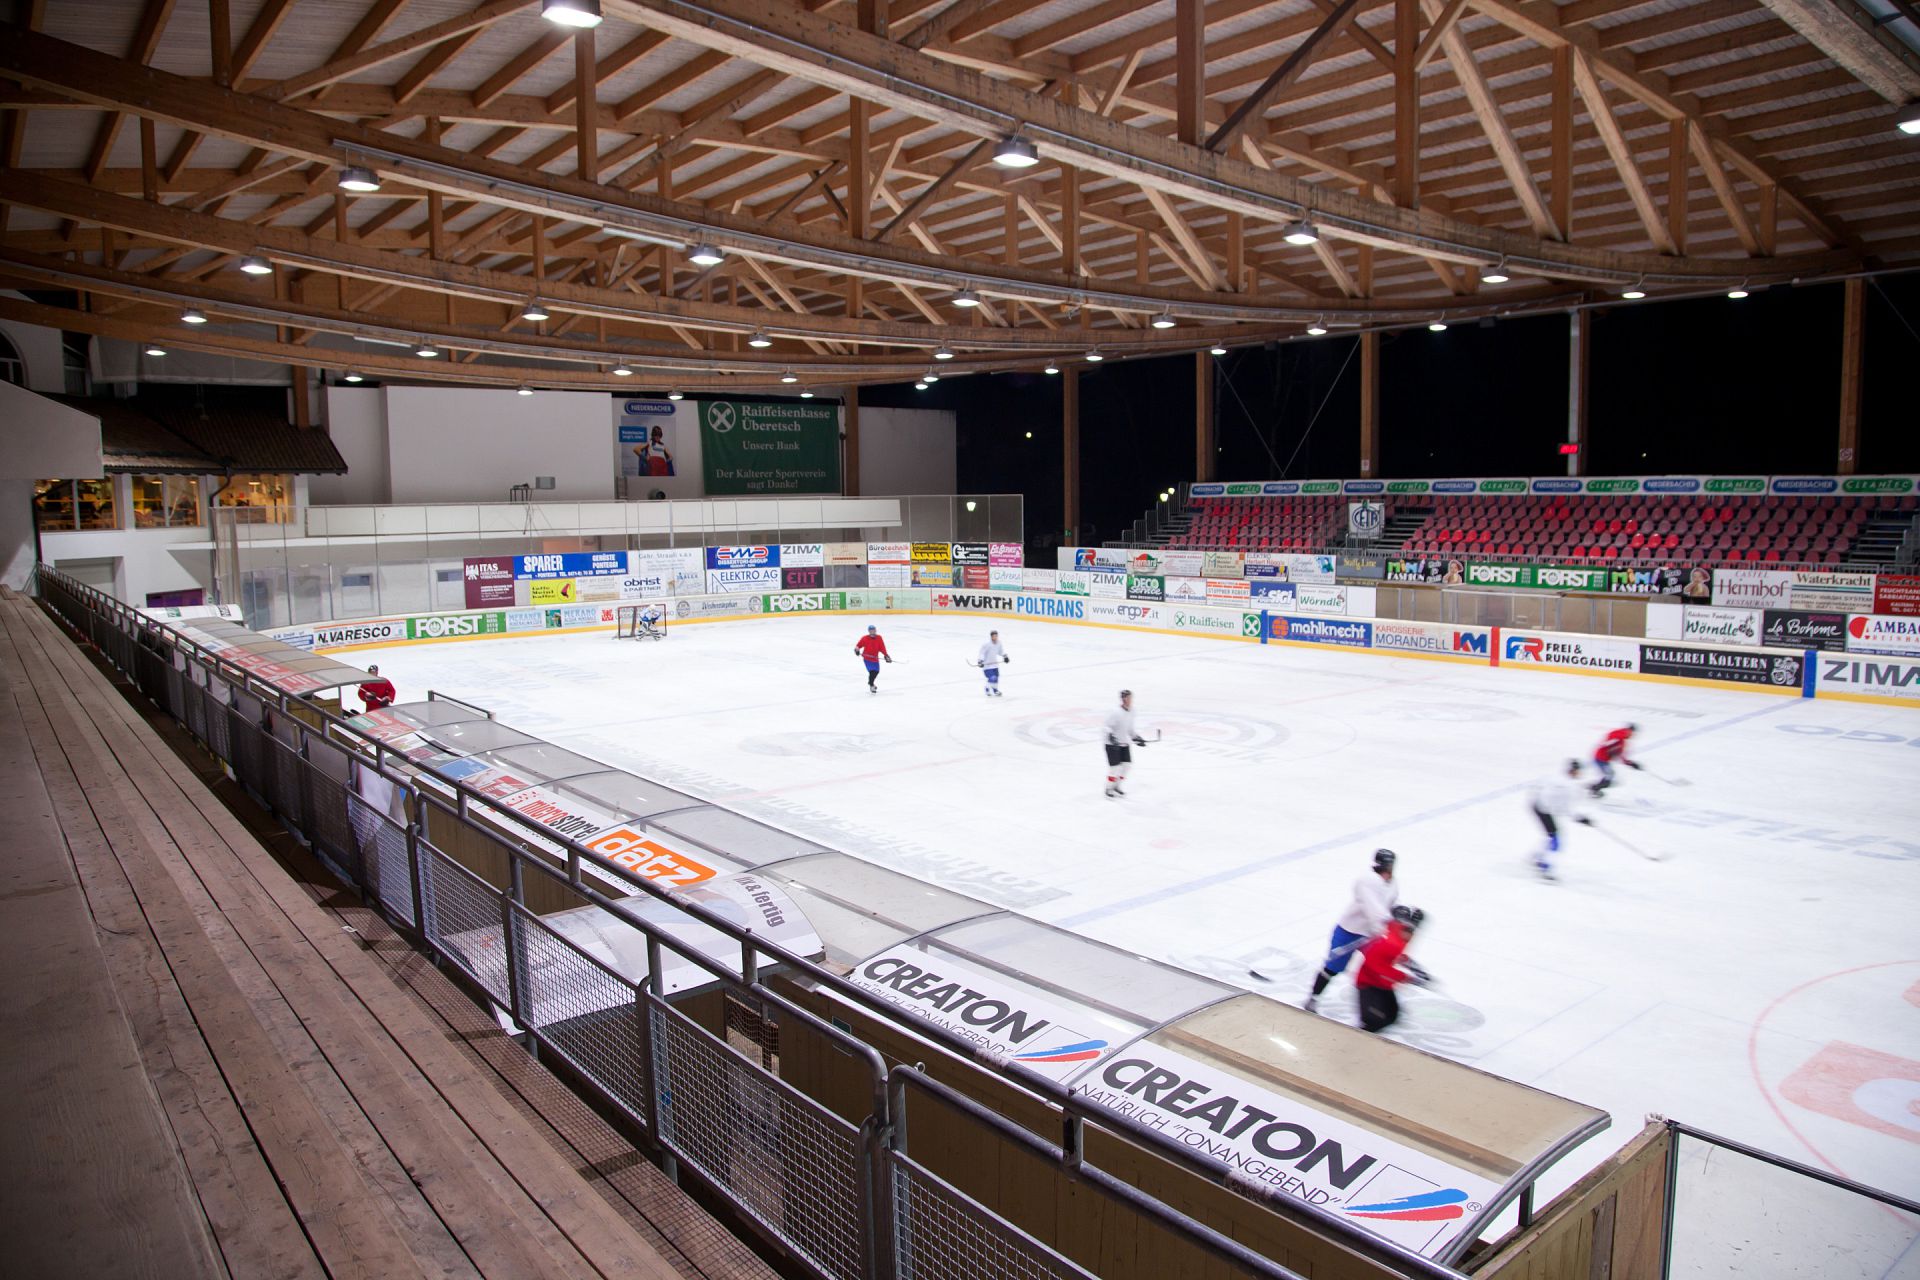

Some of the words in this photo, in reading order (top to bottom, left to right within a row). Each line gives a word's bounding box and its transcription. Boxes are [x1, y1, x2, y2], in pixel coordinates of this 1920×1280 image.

[742, 405, 830, 419] Raiffeisenkasse
[742, 419, 801, 432] Überetsch
[742, 441, 773, 450] Unsere
[777, 441, 800, 450] Bank
[716, 470, 733, 478] Der
[736, 470, 772, 478] Kalterer
[775, 469, 826, 480] Sportverein
[747, 480, 764, 490] sagt
[768, 480, 798, 489] Danke!
[480, 564, 498, 572] ITAS
[524, 555, 563, 572] SPARER
[624, 577, 661, 586] obrist
[720, 570, 760, 581] ELEKTRO
[763, 570, 778, 579] AG
[1469, 566, 1520, 583] FORST
[1538, 568, 1592, 587] FORST
[1796, 573, 1872, 587] Waterkracht
[1134, 578, 1159, 588] DECO
[770, 593, 826, 612] FORST
[952, 594, 1012, 610] WÜRTH
[1017, 596, 1084, 618] POLTRANS
[1300, 596, 1341, 606] Wörndle
[415, 614, 483, 638] FORST
[1189, 616, 1234, 628] Raiffeisen
[1291, 621, 1366, 638] mahlknecht
[1686, 620, 1739, 636] Wörndle
[1766, 618, 1784, 636] La
[1787, 618, 1842, 638] Boheme
[1874, 620, 1920, 635] AMBA
[318, 626, 391, 644] N.VARESCO
[1376, 625, 1424, 636] KAROSSERIE
[1376, 634, 1448, 650] MORANDELL
[1454, 632, 1487, 653] KM
[1546, 642, 1571, 653] FREI
[1574, 644, 1582, 654] &
[1546, 654, 1632, 670] RUNGGALDIER
[1645, 648, 1704, 664] KELLEREI
[1709, 652, 1768, 670] KALTERN
[1708, 672, 1766, 682] CALDARO
[518, 800, 600, 839] microstore
[592, 833, 701, 886] datz
[752, 891, 786, 928] fertig
[863, 958, 1050, 1044] CREATON
[1076, 1084, 1170, 1132] NATÜRLICH
[1102, 1058, 1378, 1190] CREATON
